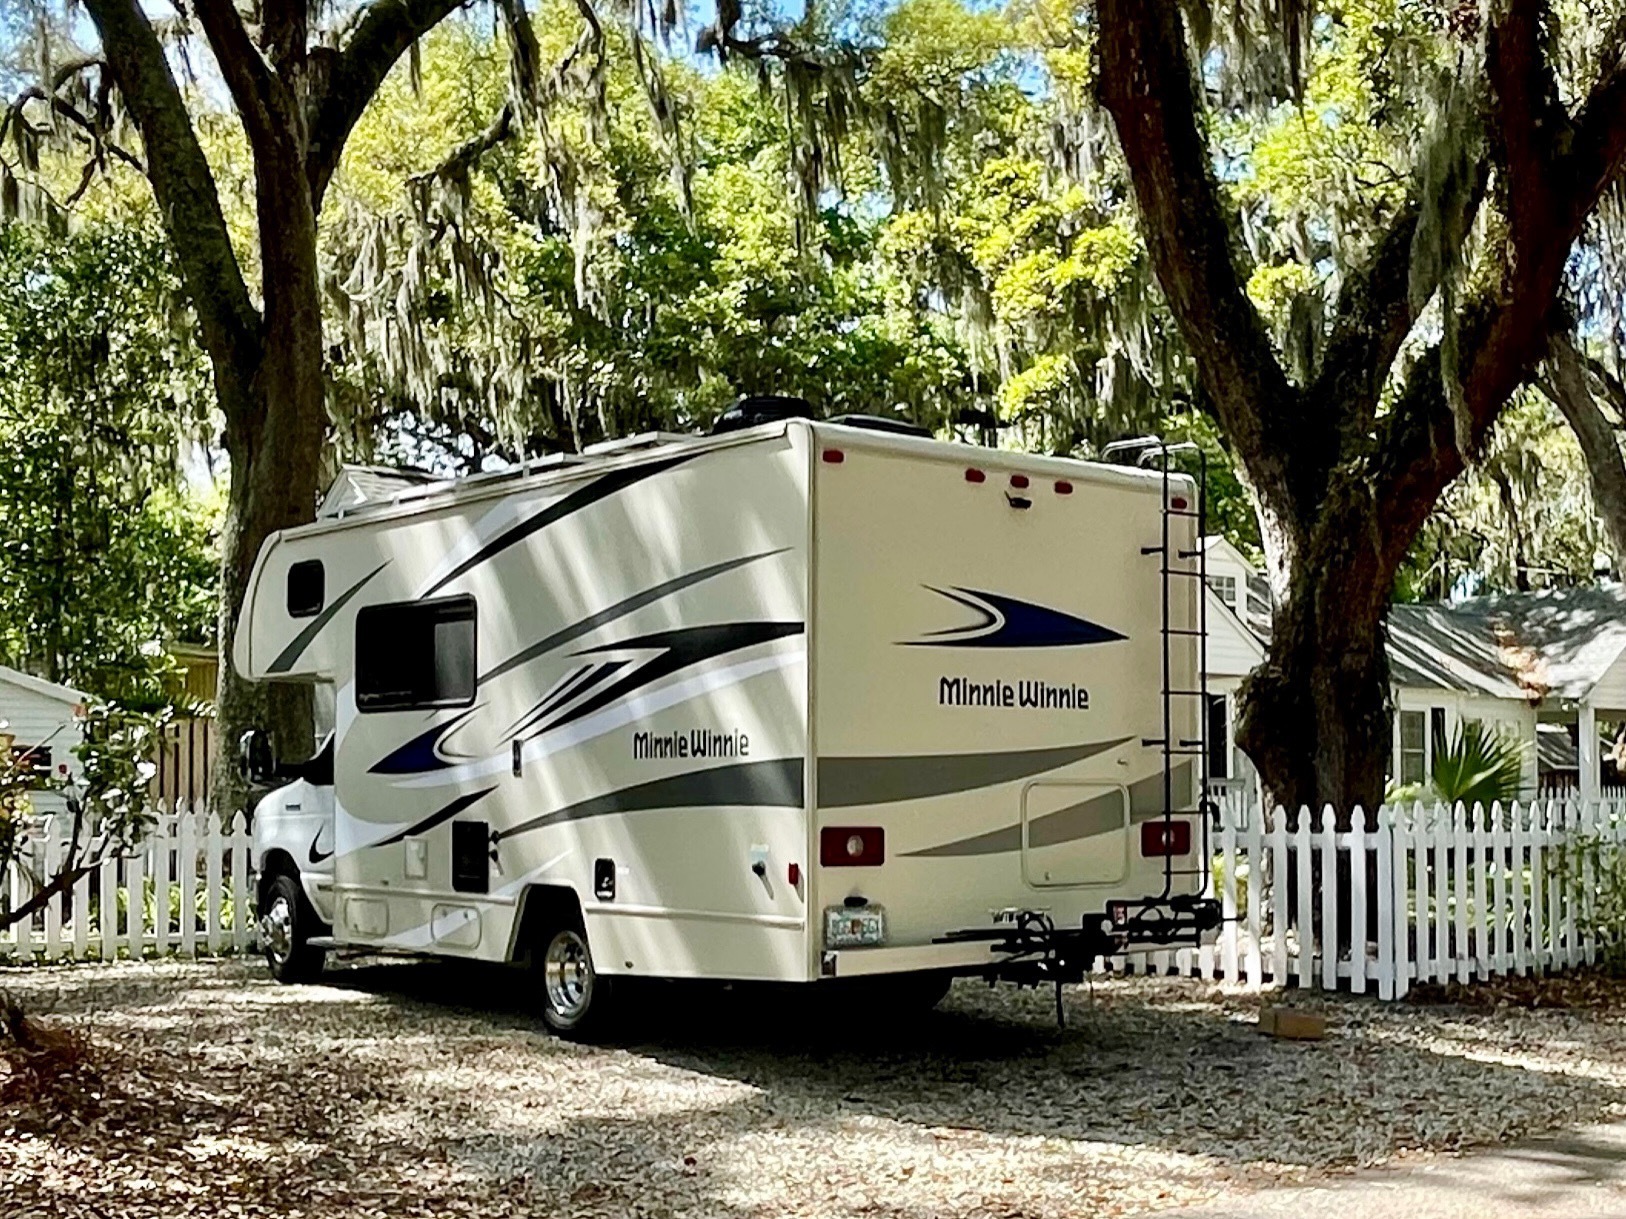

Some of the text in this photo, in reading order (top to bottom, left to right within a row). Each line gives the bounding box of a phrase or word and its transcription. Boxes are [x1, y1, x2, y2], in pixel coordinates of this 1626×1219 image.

[939, 676, 1089, 710] Minnie Winnie
[633, 728, 749, 759] Minnie Winnie
